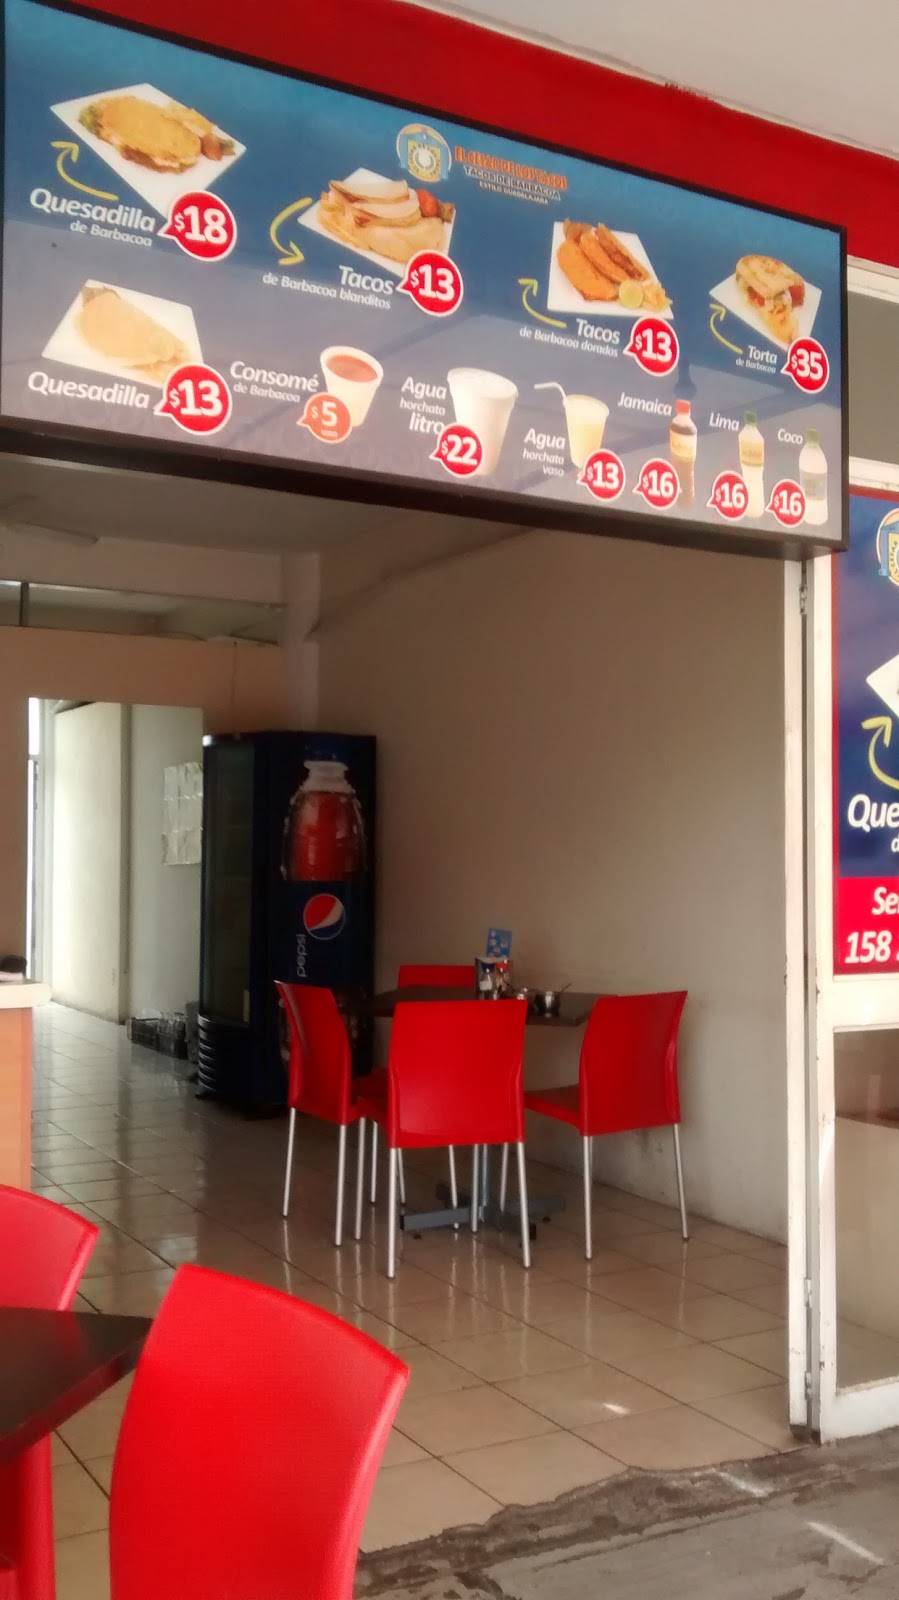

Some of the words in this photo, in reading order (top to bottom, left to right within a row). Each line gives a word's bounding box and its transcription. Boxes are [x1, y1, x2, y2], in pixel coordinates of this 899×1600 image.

[30, 188, 156, 231] Quesadilla
[70, 220, 87, 234] de
[90, 226, 153, 247] Barbacoa
[174, 205, 228, 245] $18
[262, 272, 279, 286] de
[281, 275, 337, 298] Barbacoa
[339, 286, 391, 310] blanditos
[339, 264, 395, 296] Tacos
[410, 264, 455, 301] $13
[519, 326, 532, 339] de
[534, 329, 579, 349] Barbacoa
[581, 338, 618, 358] dorados
[576, 318, 621, 345] Tacos
[635, 328, 673, 363] $13
[748, 344, 778, 365] Torta
[791, 348, 824, 380] $35
[28, 371, 150, 409] Quesadilla
[230, 361, 319, 392] Consomé
[401, 376, 447, 400] Agua
[169, 379, 223, 417] $13
[233, 382, 248, 394] de
[250, 384, 300, 403] Barbacoa
[400, 397, 446, 416] horchata
[618, 392, 672, 417] Jamaica
[409, 412, 445, 436] litro
[709, 412, 740, 432] Lima
[441, 434, 478, 466] $22
[524, 428, 566, 450] Agua
[777, 428, 803, 445] Coco
[522, 448, 564, 465] horchata
[587, 460, 620, 489] $13
[642, 470, 674, 498] $16
[715, 482, 745, 509] $16
[774, 490, 801, 516] $16
[296, 934, 307, 977] pepsi
[845, 930, 893, 964] 158
